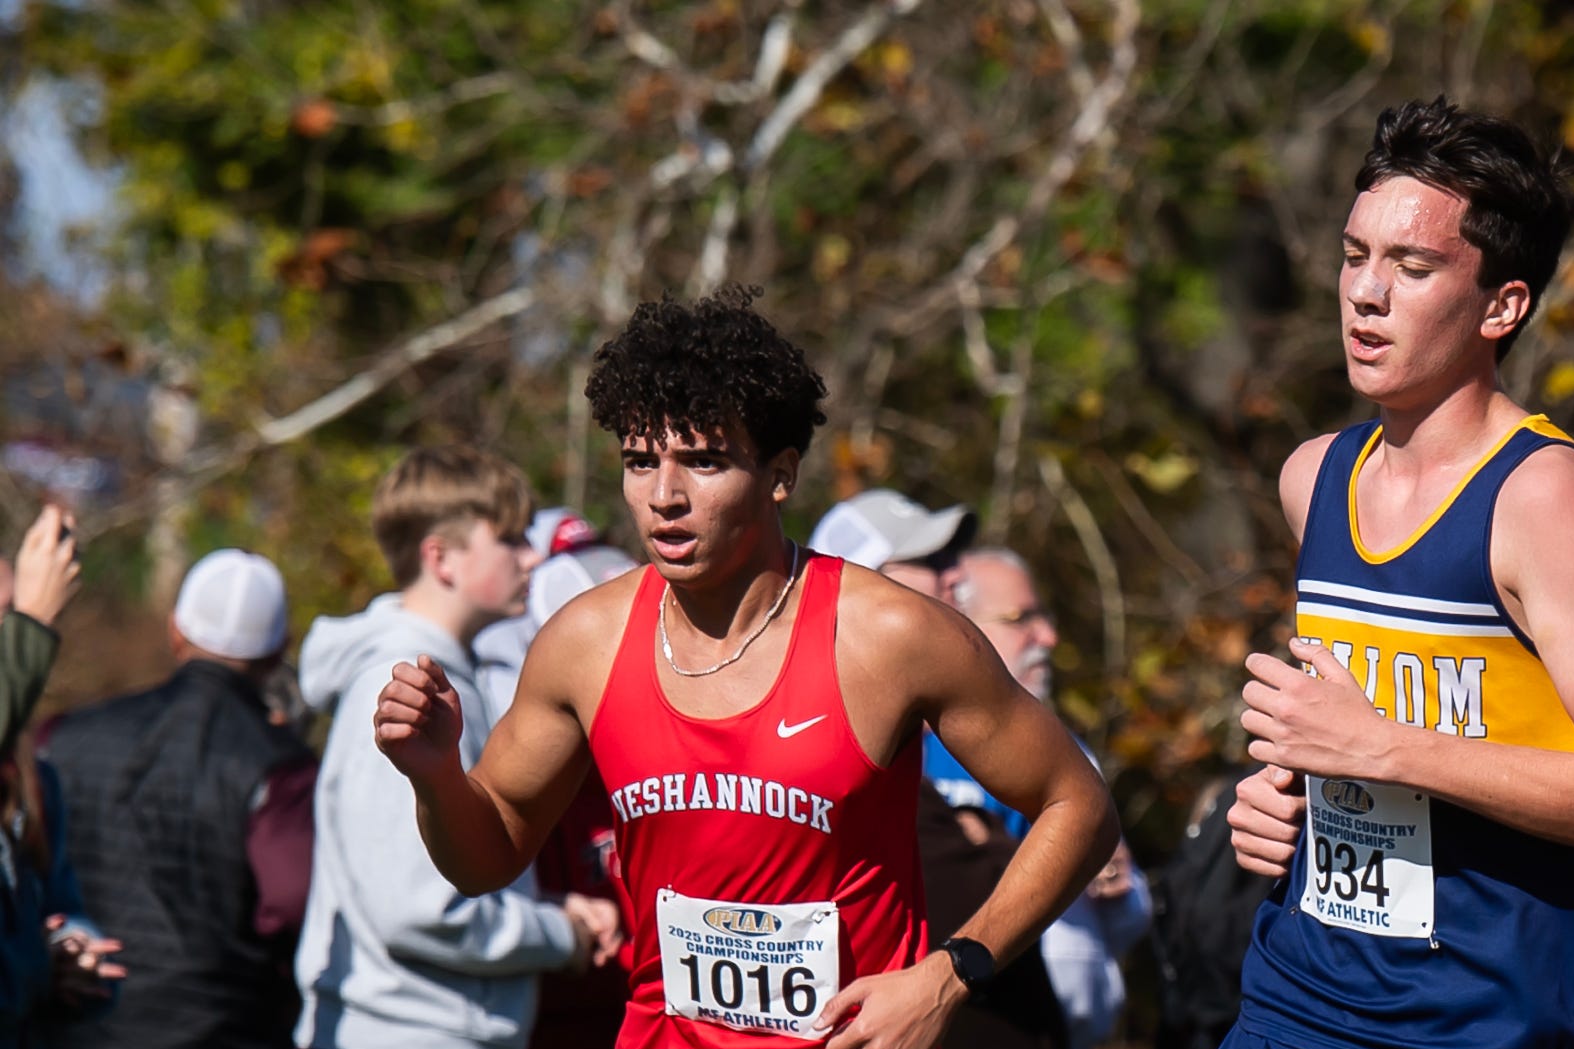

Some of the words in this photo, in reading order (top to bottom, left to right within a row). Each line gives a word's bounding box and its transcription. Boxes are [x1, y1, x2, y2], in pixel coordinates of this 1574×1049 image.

[1299, 636, 1488, 740] LOM
[1321, 808, 1353, 829] CROSS
[1354, 820, 1418, 837] COUNTRY
[1314, 835, 1390, 908] 934
[715, 909, 777, 934] PIAA
[1327, 901, 1391, 928] ATHLETIC
[667, 924, 703, 943] 2025
[705, 934, 753, 950] CROSS
[756, 939, 824, 953] COUNTRY
[686, 941, 805, 965] CHAMPIONSHIPS
[679, 953, 818, 1018] 1016
[723, 1011, 800, 1033] ATHLETIC
